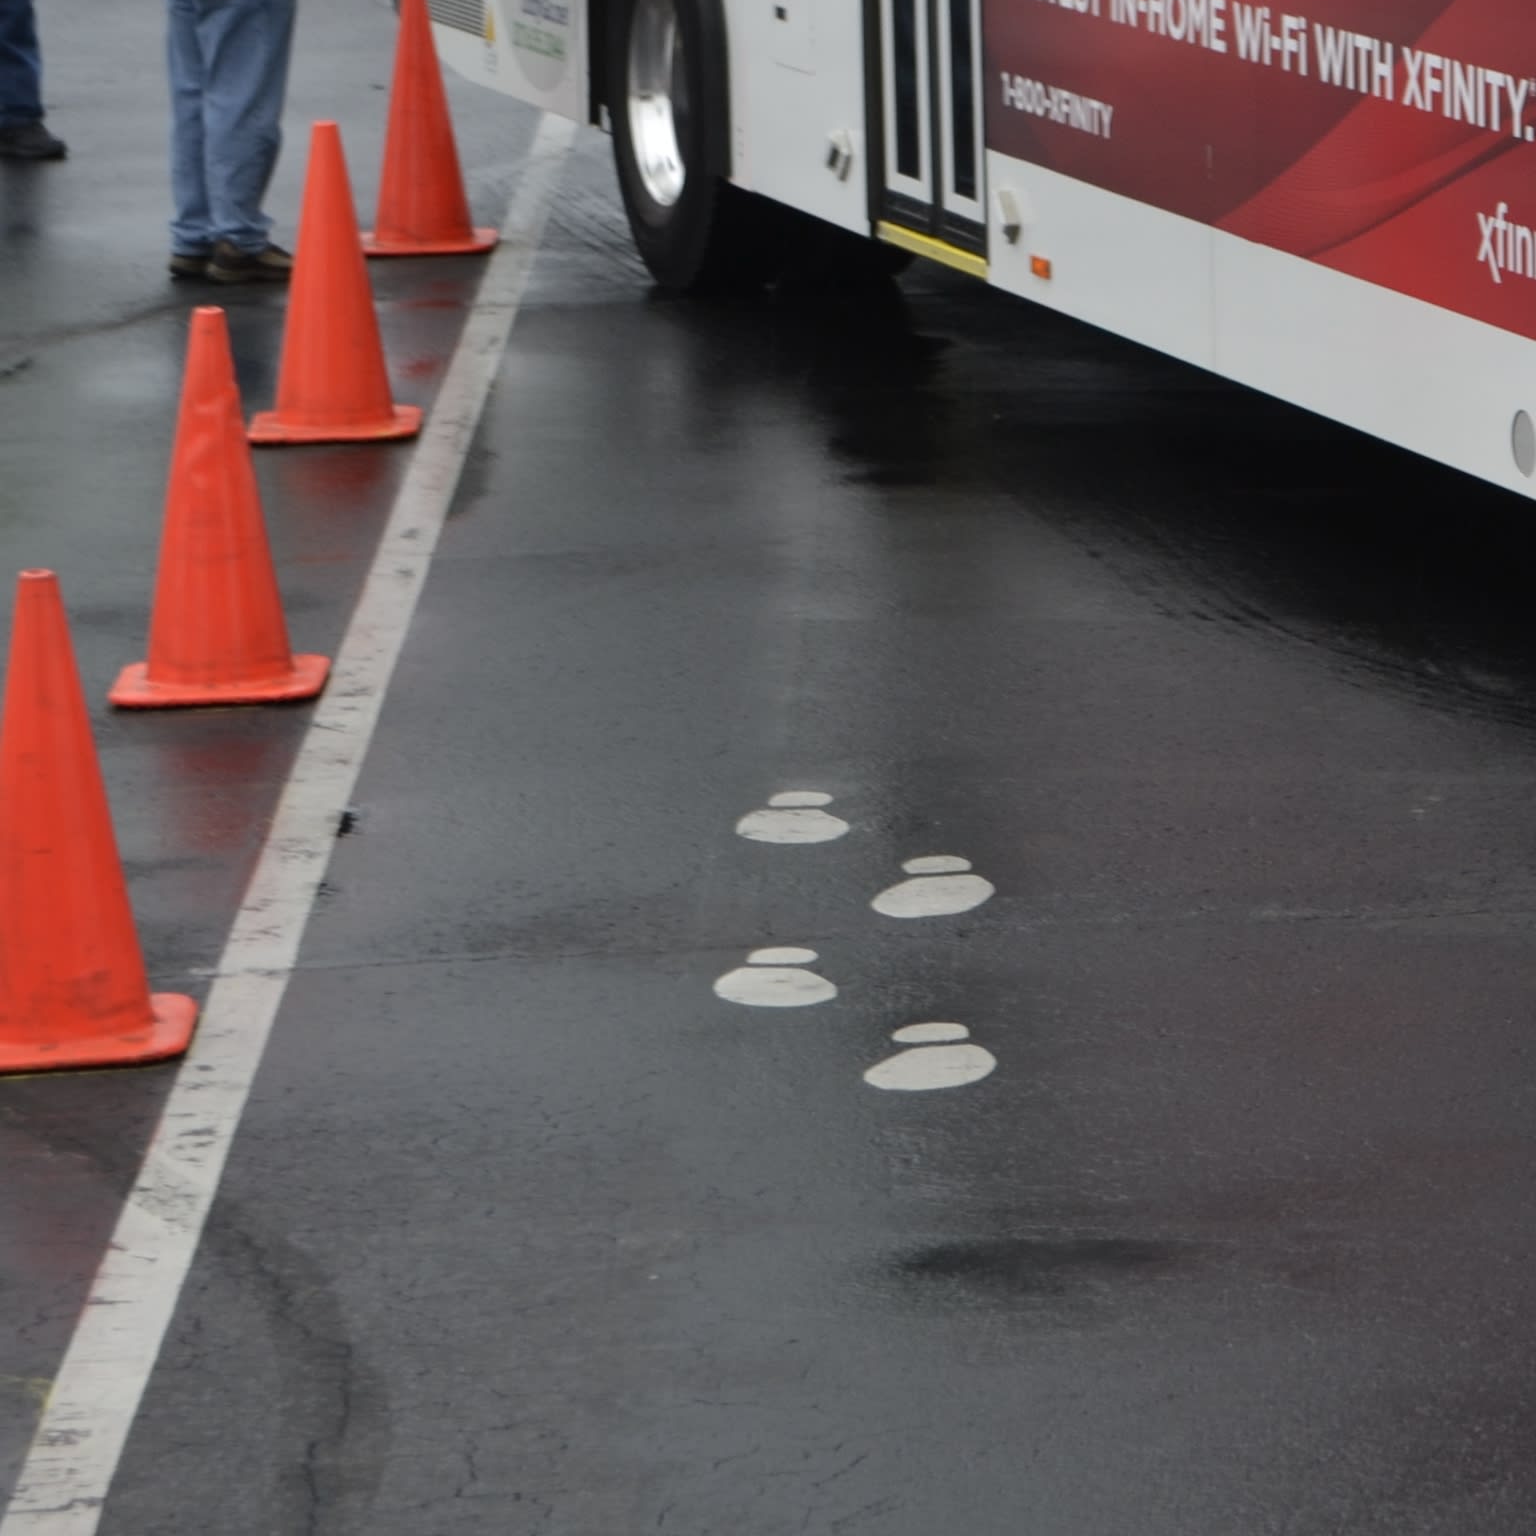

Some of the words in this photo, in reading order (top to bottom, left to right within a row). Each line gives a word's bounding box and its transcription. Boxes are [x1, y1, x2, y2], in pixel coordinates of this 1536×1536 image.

[1232, 0, 1307, 76] Wi-Fi
[1314, 24, 1394, 101] WITH
[1000, 71, 1114, 140] 1-800-XFINITY
